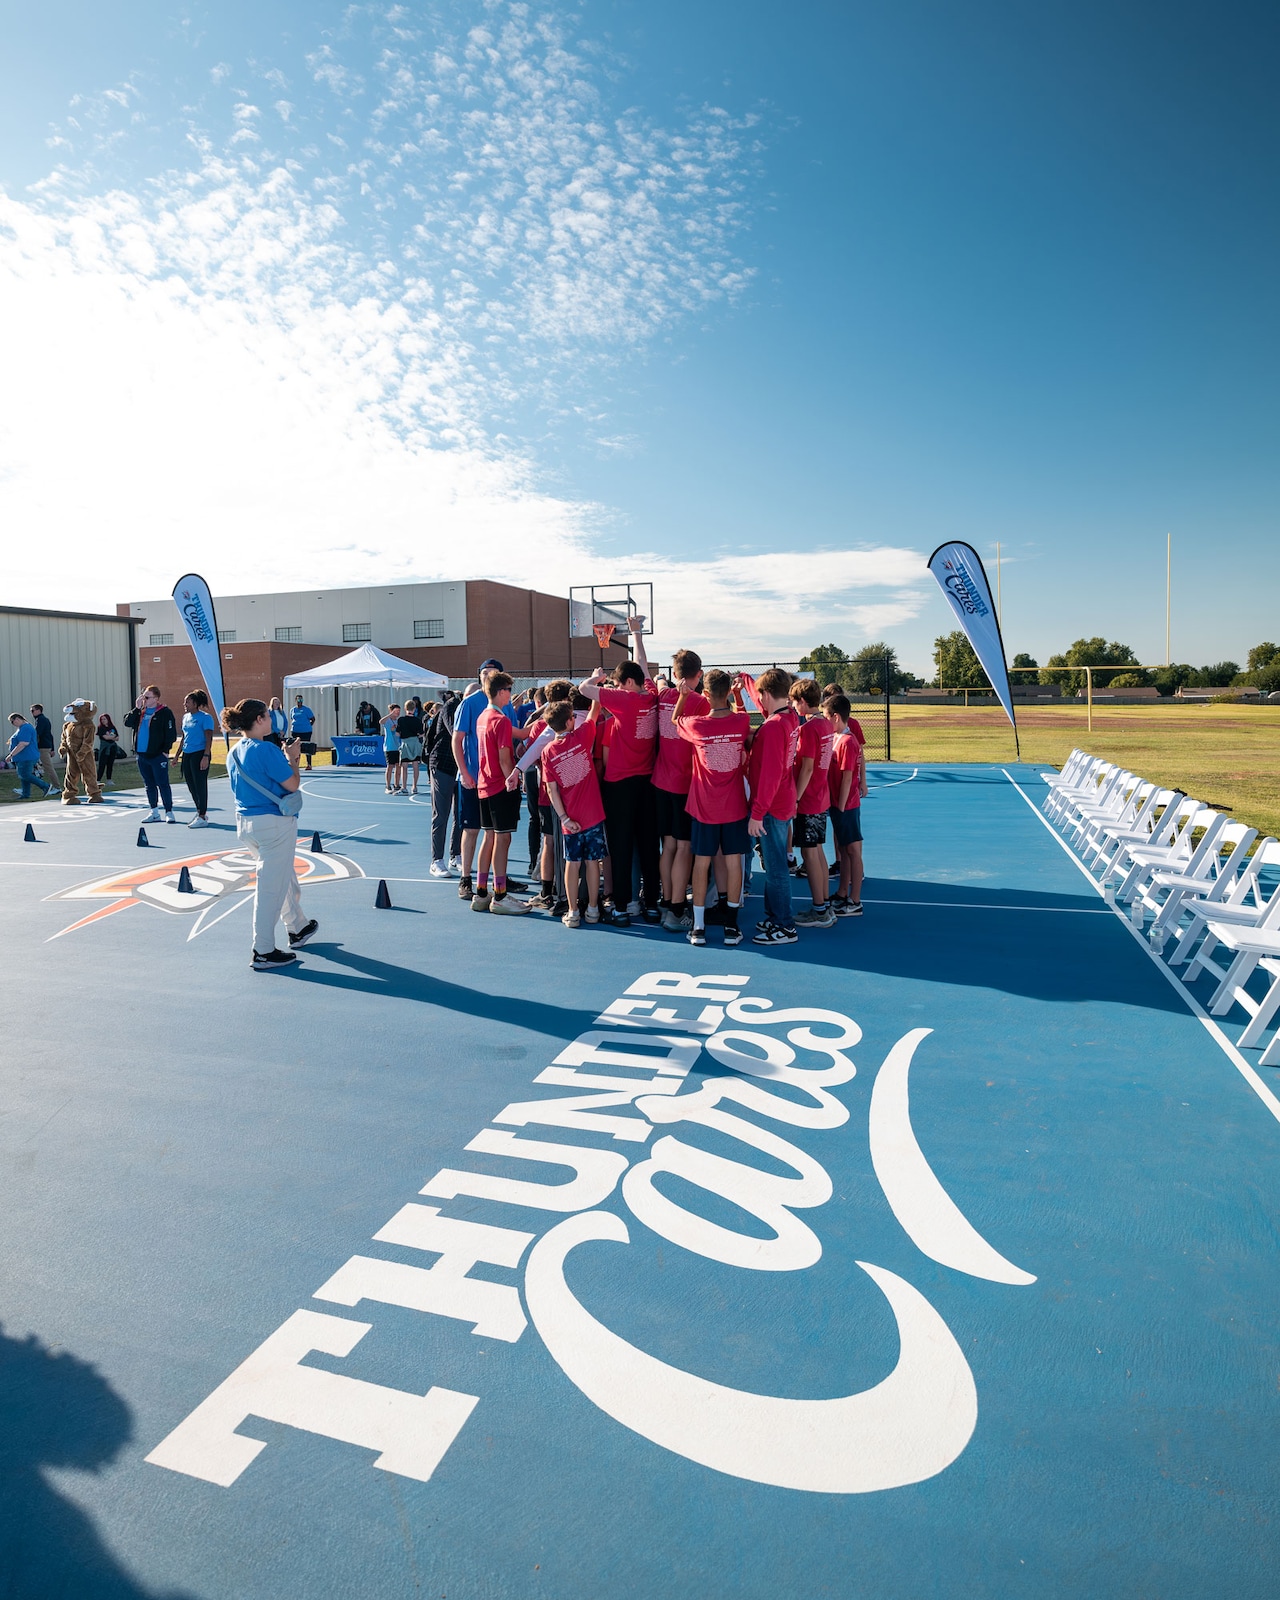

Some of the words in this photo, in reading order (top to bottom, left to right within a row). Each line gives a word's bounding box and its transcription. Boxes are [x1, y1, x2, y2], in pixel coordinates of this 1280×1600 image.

[945, 574, 978, 614] Cares
[956, 562, 989, 617] THUNDER
[183, 603, 205, 640] Cares
[191, 592, 214, 643] THUNDER
[351, 744, 376, 757] Cares
[145, 971, 751, 1488] THUNDER
[525, 996, 978, 1494] Cares
